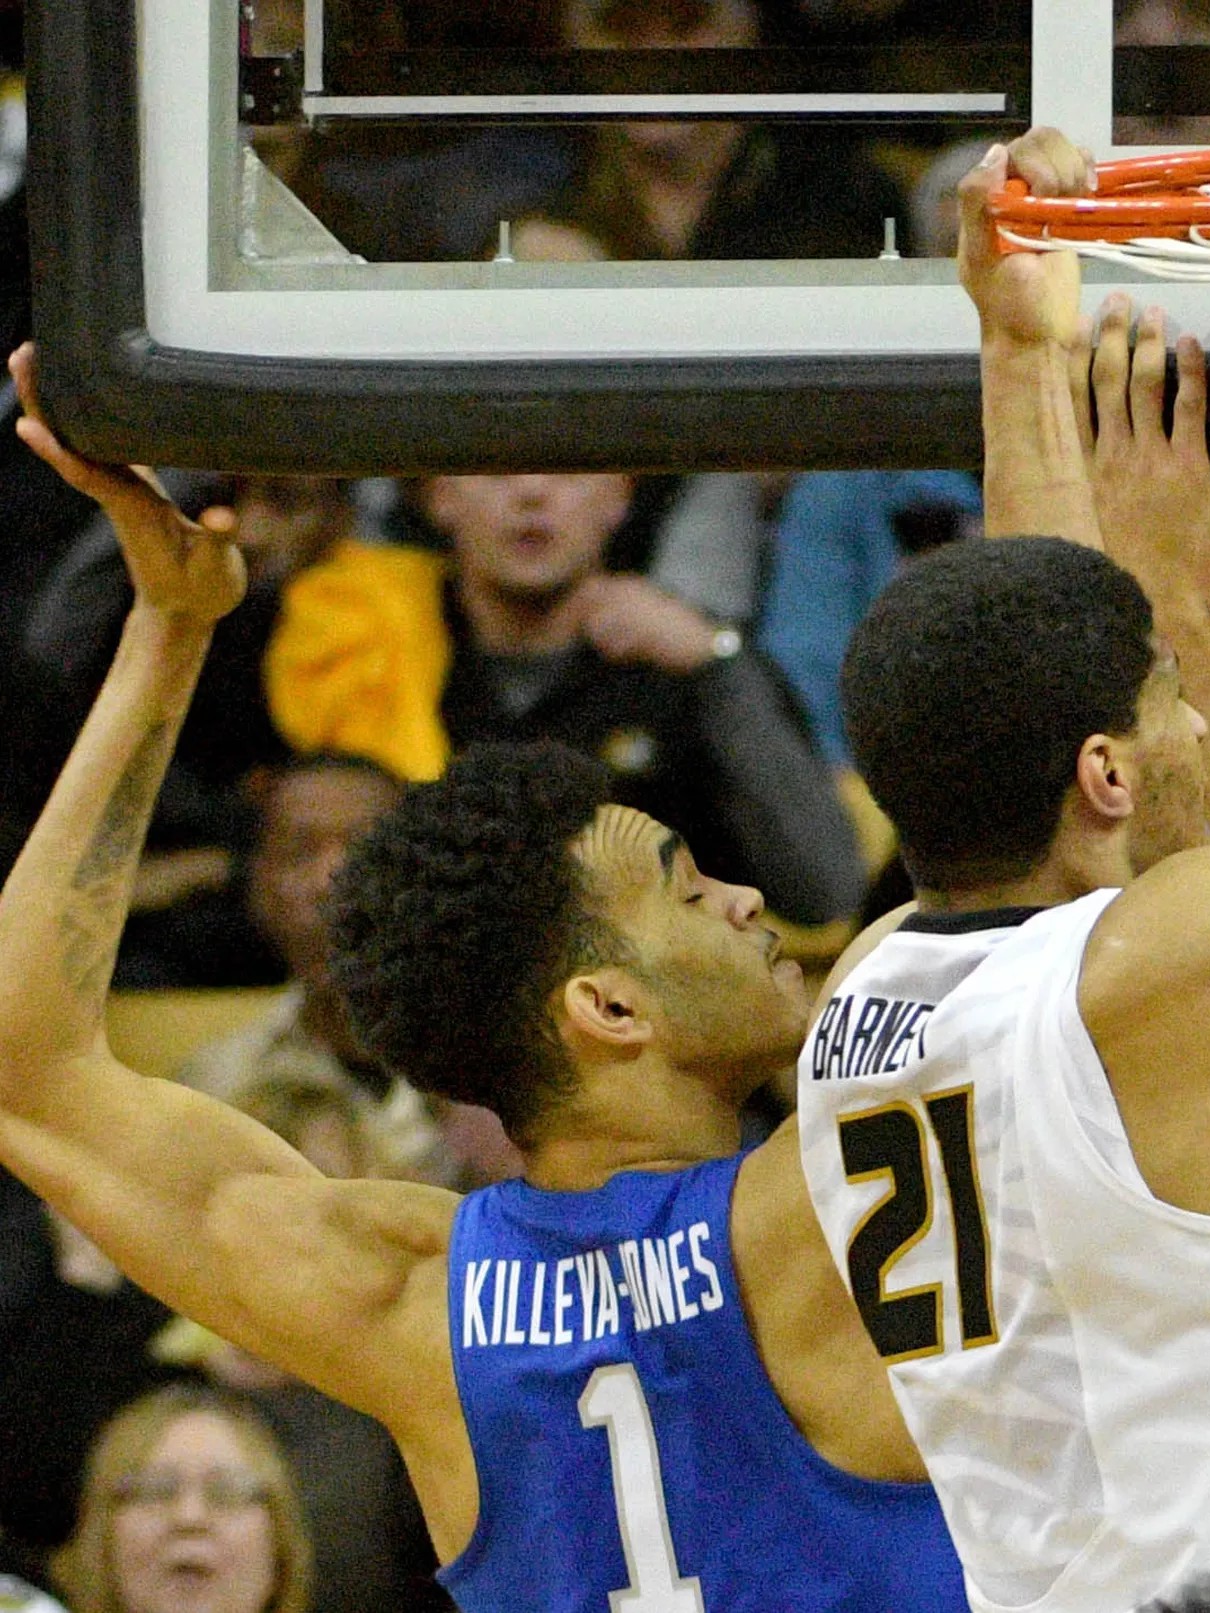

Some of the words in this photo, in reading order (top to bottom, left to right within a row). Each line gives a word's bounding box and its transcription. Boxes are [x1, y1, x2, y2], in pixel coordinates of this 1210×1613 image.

[812, 994, 936, 1080] BARNE
[836, 1082, 999, 1366] 21
[577, 1362, 705, 1613] 1
